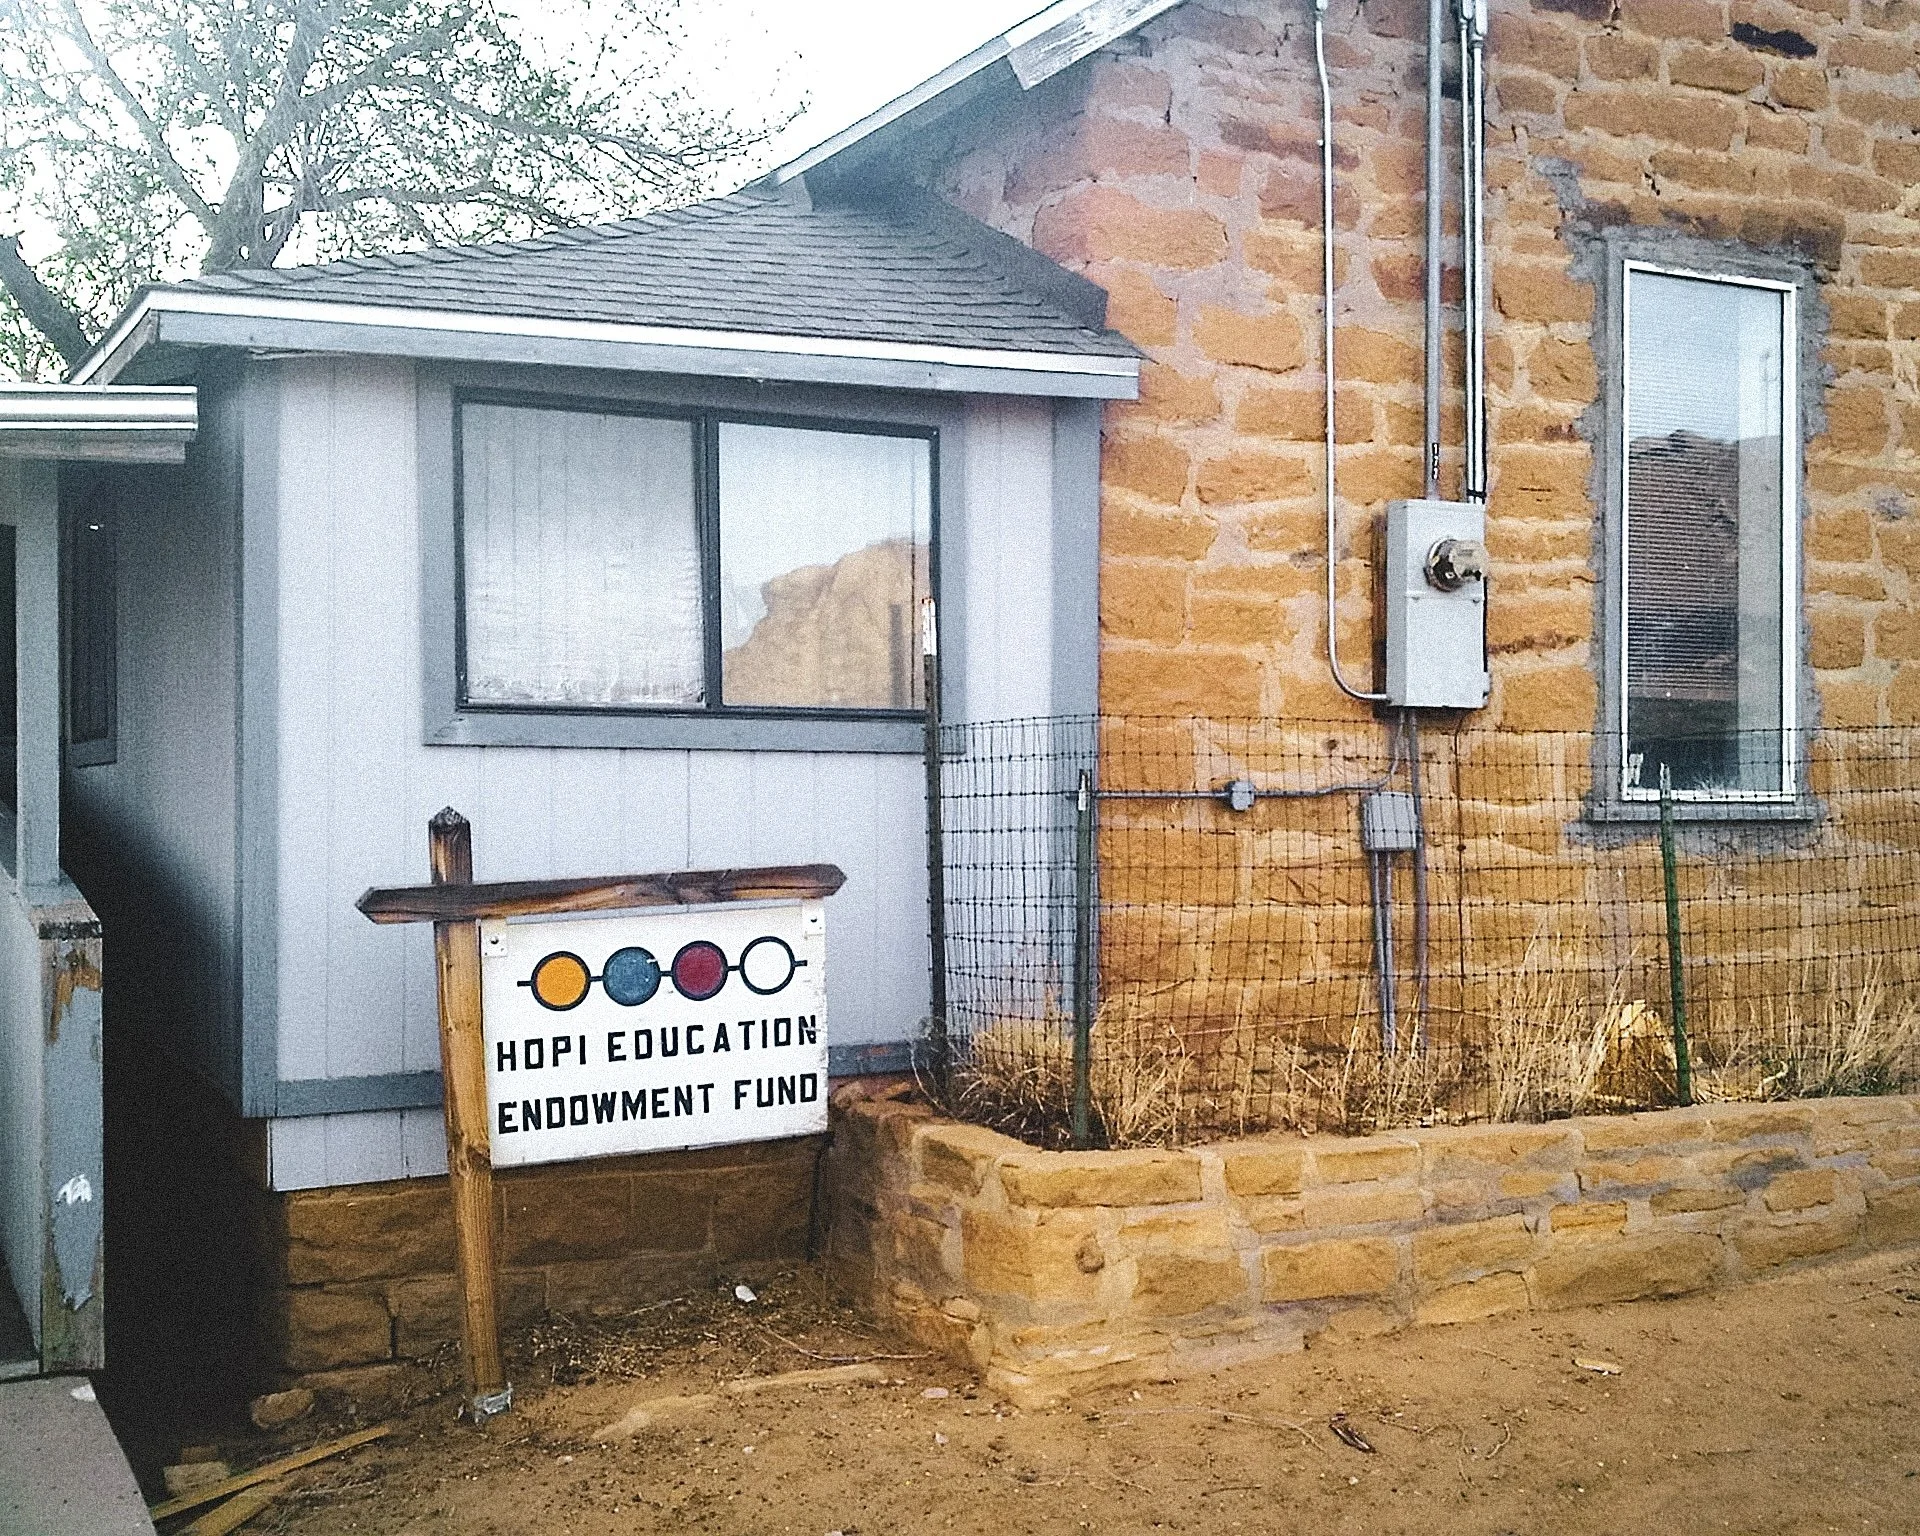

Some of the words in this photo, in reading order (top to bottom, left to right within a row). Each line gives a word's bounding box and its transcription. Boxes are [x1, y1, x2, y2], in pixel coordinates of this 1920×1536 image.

[497, 1035, 586, 1072] HOPI
[607, 1015, 817, 1062] EDUCATION
[499, 1083, 714, 1134] ENDOWMENT
[734, 1073, 818, 1110] FUND
